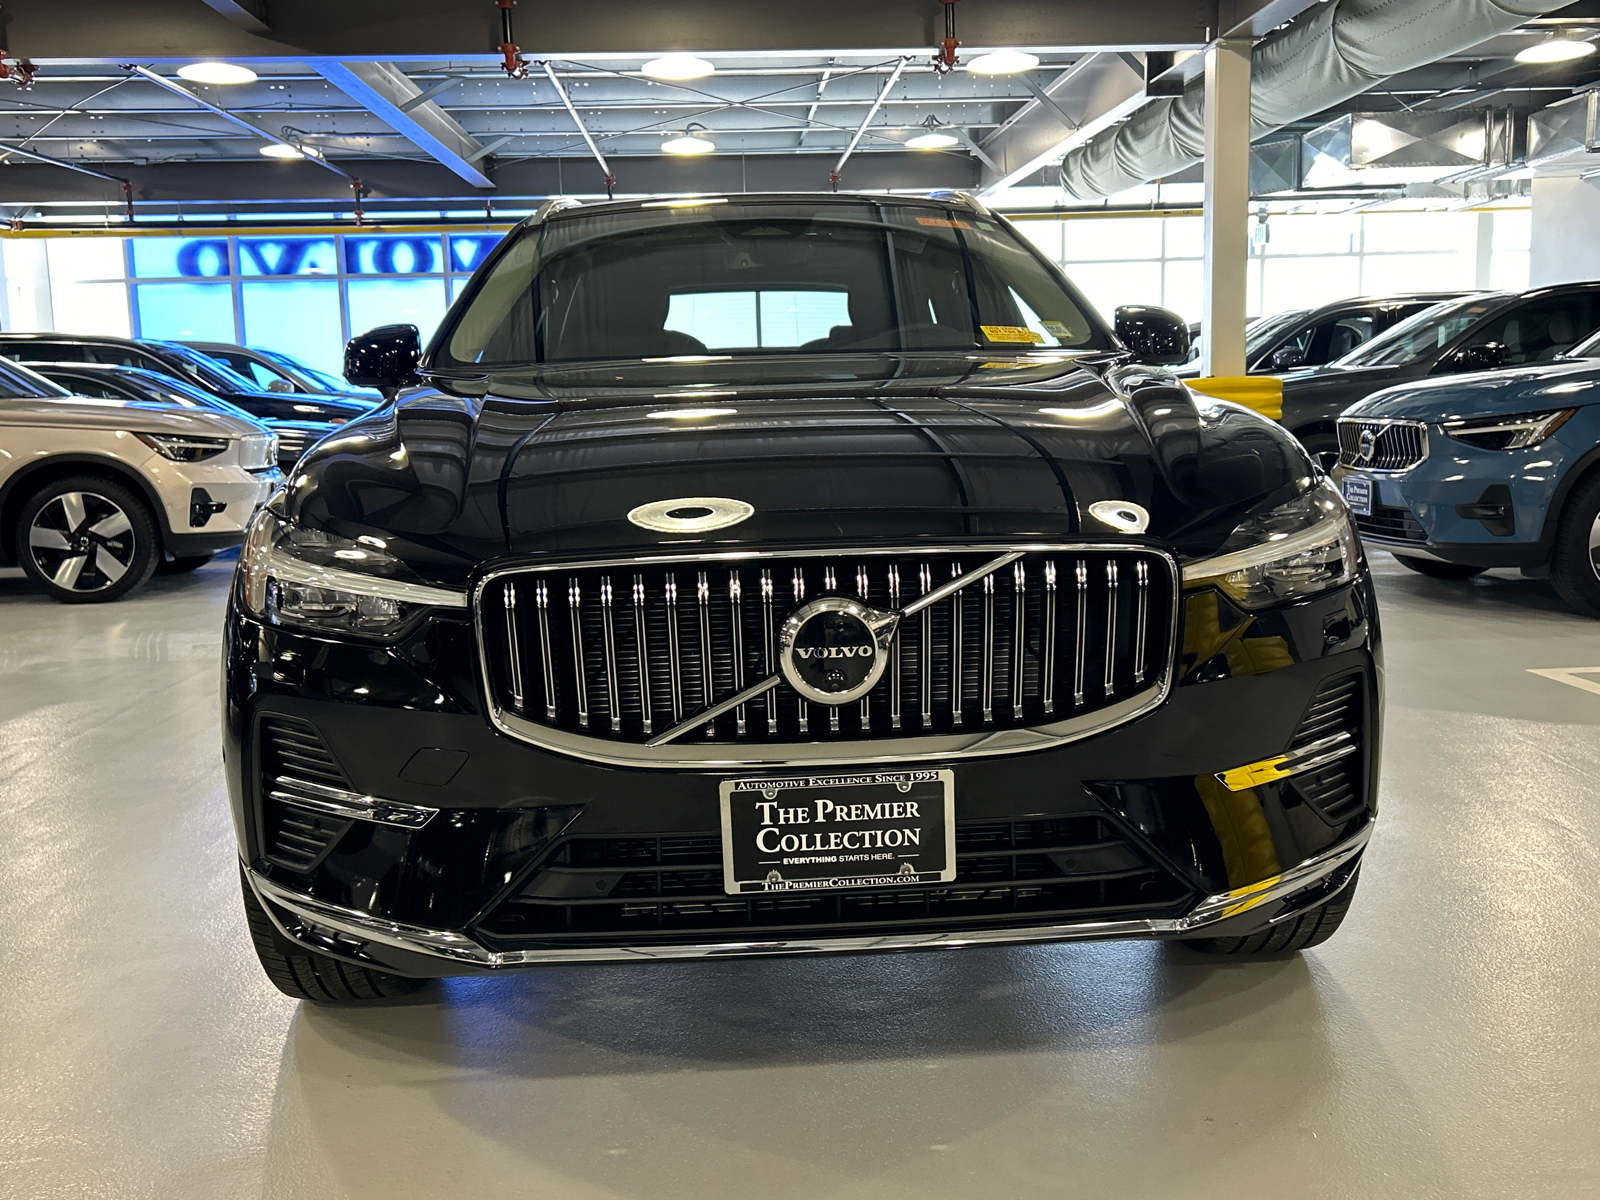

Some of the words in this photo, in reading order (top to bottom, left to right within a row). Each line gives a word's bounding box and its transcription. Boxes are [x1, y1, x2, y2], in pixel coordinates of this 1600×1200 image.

[795, 645, 873, 659] VOLVO
[738, 780, 806, 790] AUTOMOTIVE
[808, 777, 873, 787] EXCELLENCE
[875, 774, 906, 783] SINCE
[909, 771, 938, 781] 1995
[755, 801, 810, 825] THE
[814, 799, 921, 823] PREMIER
[756, 828, 921, 853] COLLECTION
[783, 856, 837, 865] EVERYTHING
[839, 854, 870, 863] STARTS
[871, 853, 895, 861] HERE.
